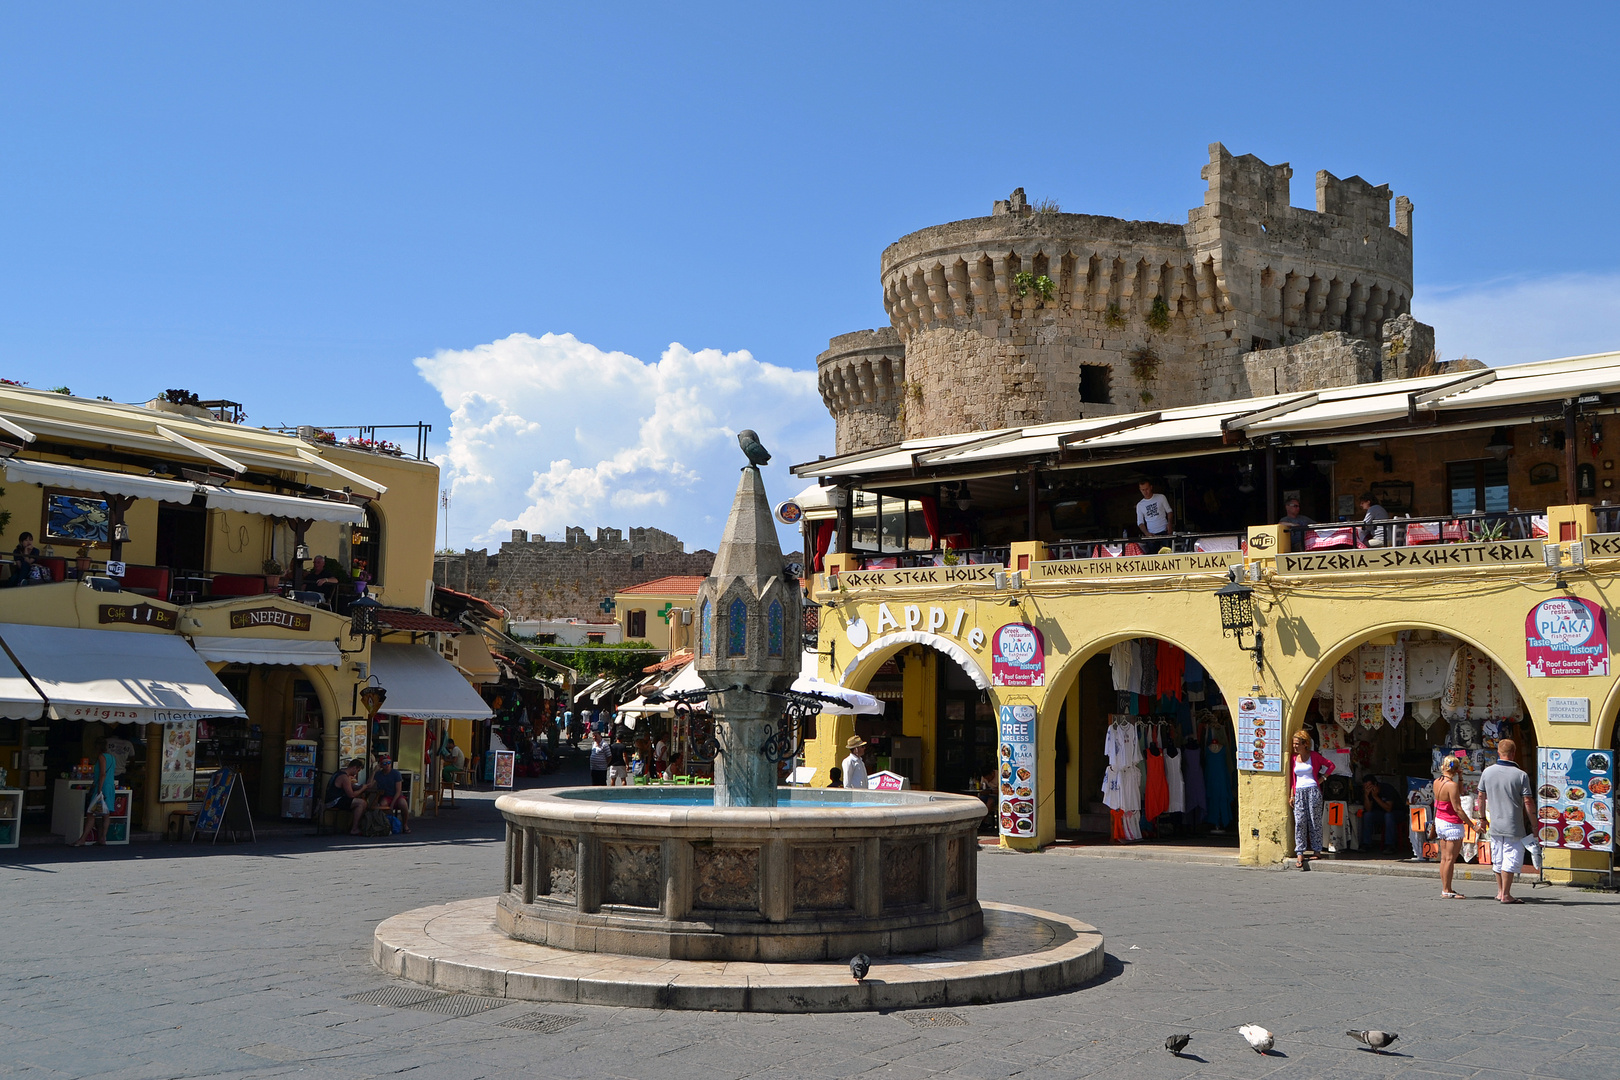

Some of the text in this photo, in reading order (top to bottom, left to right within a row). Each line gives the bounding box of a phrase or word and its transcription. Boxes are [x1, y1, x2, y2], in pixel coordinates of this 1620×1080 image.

[1116, 559, 1181, 572] RESTAURANT
[1185, 554, 1231, 569] "PLAKA"
[1285, 544, 1534, 571] PIZZERIA-SPAGHETTERIA
[847, 567, 995, 586] GREEK STEAK HOUSE
[250, 611, 294, 627] NEFELI
[877, 602, 984, 650] Apple
[1541, 620, 1589, 634] PLAKA
[1003, 642, 1033, 652] PLAKA
[1528, 637, 1602, 655] Taste with history!
[75, 707, 137, 719] stigma
[1002, 724, 1028, 734] FREE
[1541, 762, 1568, 771] PLAKA
[1331, 805, 1338, 824] 1
[1413, 810, 1421, 830] 1
[1479, 844, 1488, 862] 1
